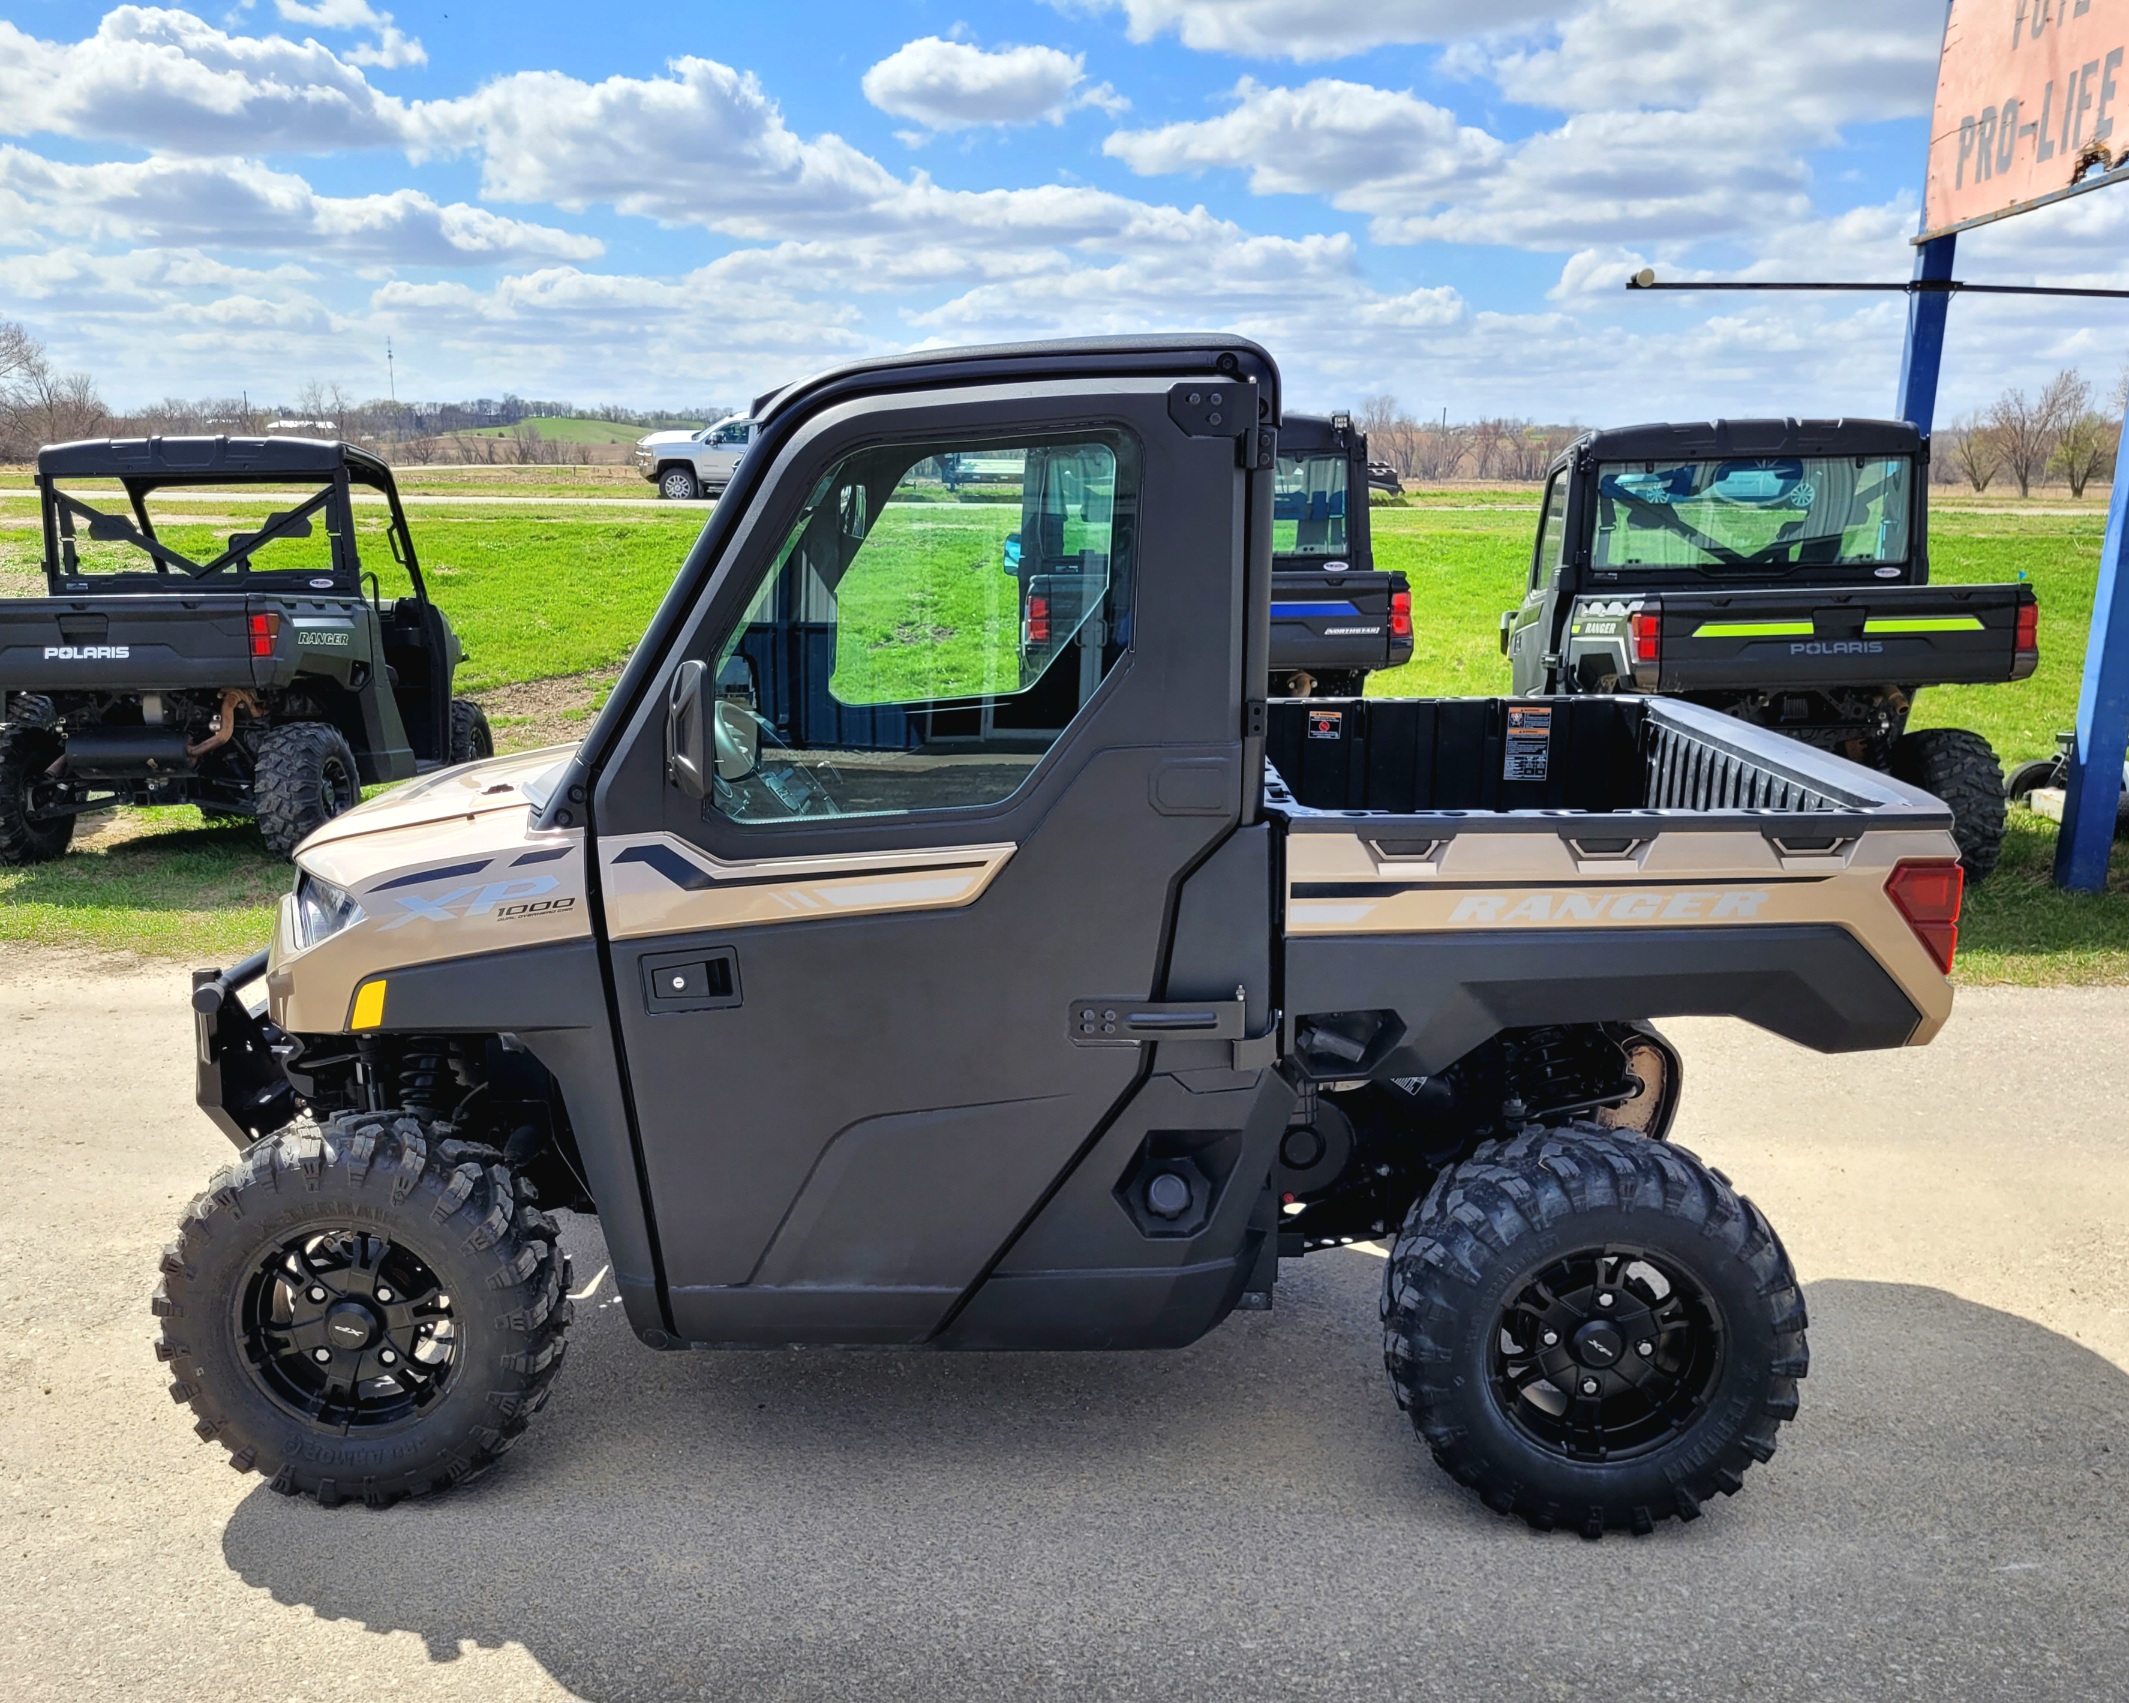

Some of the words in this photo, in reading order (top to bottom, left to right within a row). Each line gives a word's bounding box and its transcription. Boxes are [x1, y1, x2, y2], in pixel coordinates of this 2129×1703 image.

[1955, 46, 2124, 191] PRO-LIFE
[1585, 622, 1616, 634] RANGER
[298, 631, 349, 646] RANGER
[44, 646, 130, 660] POLARIS
[1790, 641, 1883, 655] POLARIS
[376, 874, 560, 932] XP
[497, 898, 575, 917] 1000
[1447, 891, 1771, 922] RANGER
